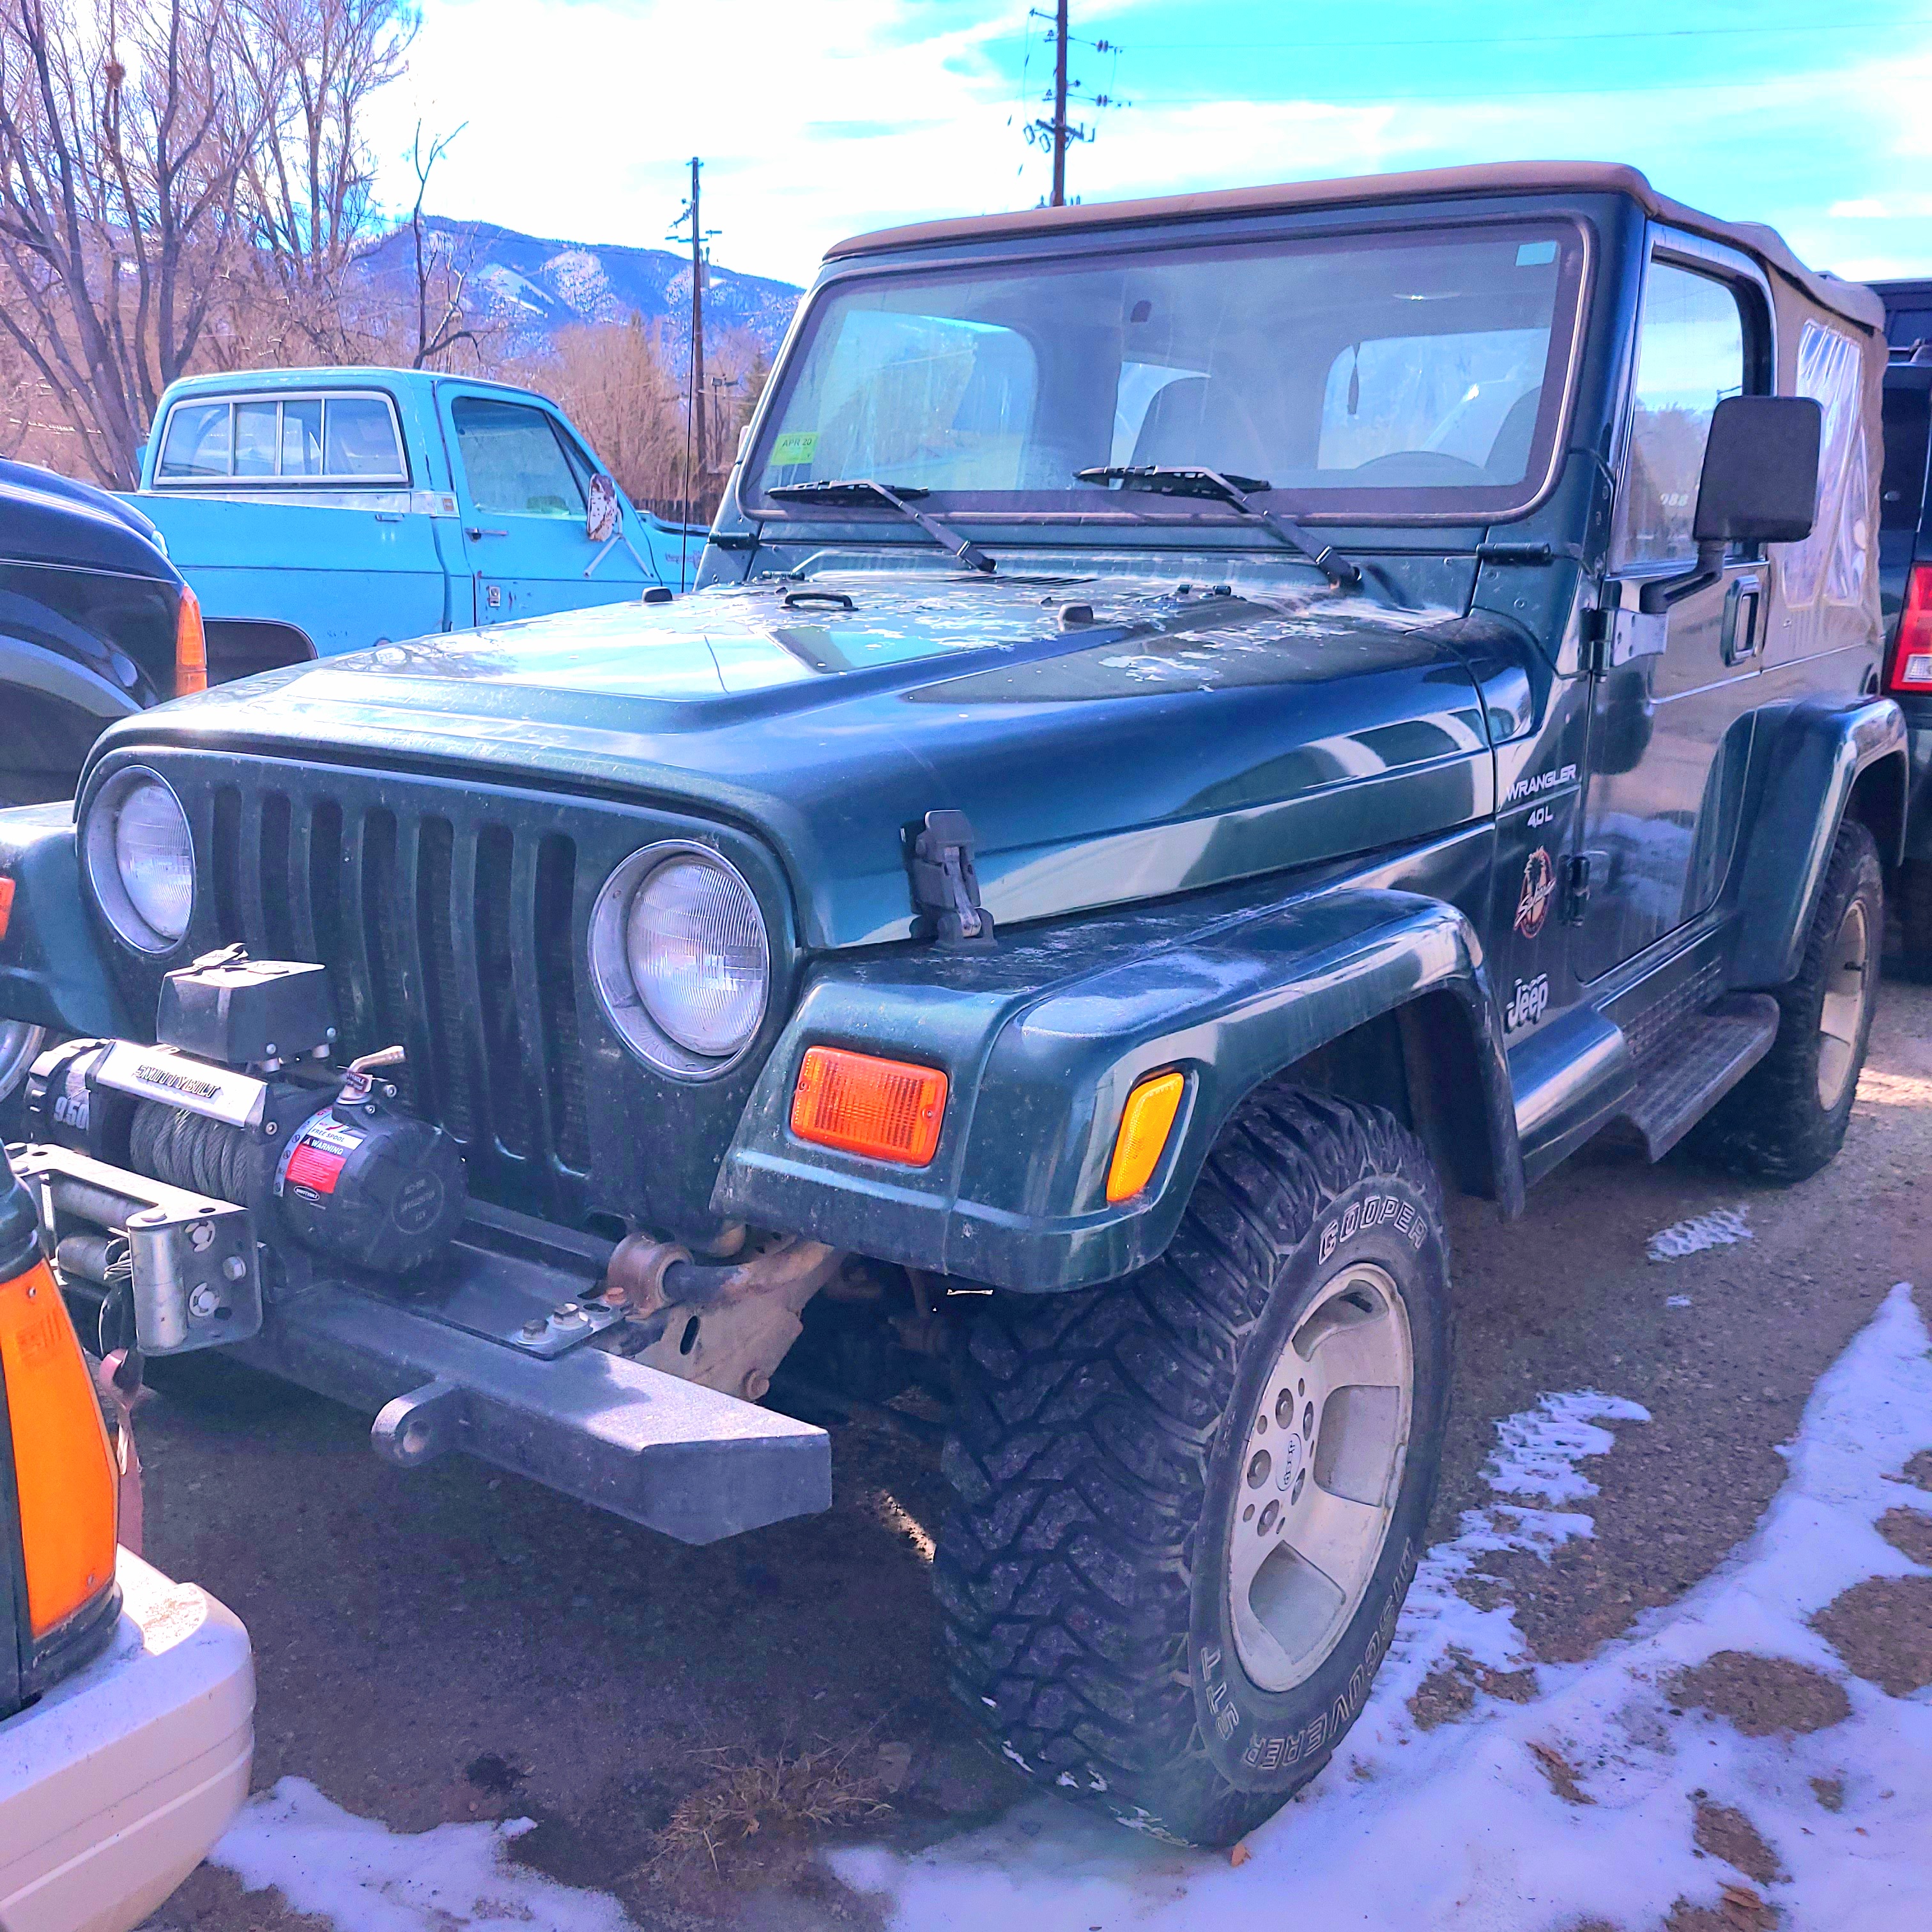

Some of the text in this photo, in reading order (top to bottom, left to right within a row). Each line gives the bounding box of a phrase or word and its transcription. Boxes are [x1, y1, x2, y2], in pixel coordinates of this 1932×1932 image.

[782, 438, 812, 447] APR 20
[1506, 763, 1577, 802] WRANGLER
[1506, 972, 1549, 1029] Jeep
[134, 1064, 222, 1098] SMITTYBILT
[310, 1128, 345, 1143] FREE SPOOL
[310, 1138, 344, 1155] WARNING
[1319, 1195, 1429, 1266] COOPER
[1284, 1439, 1296, 1485] Jeep
[1200, 1646, 1240, 1740] STT
